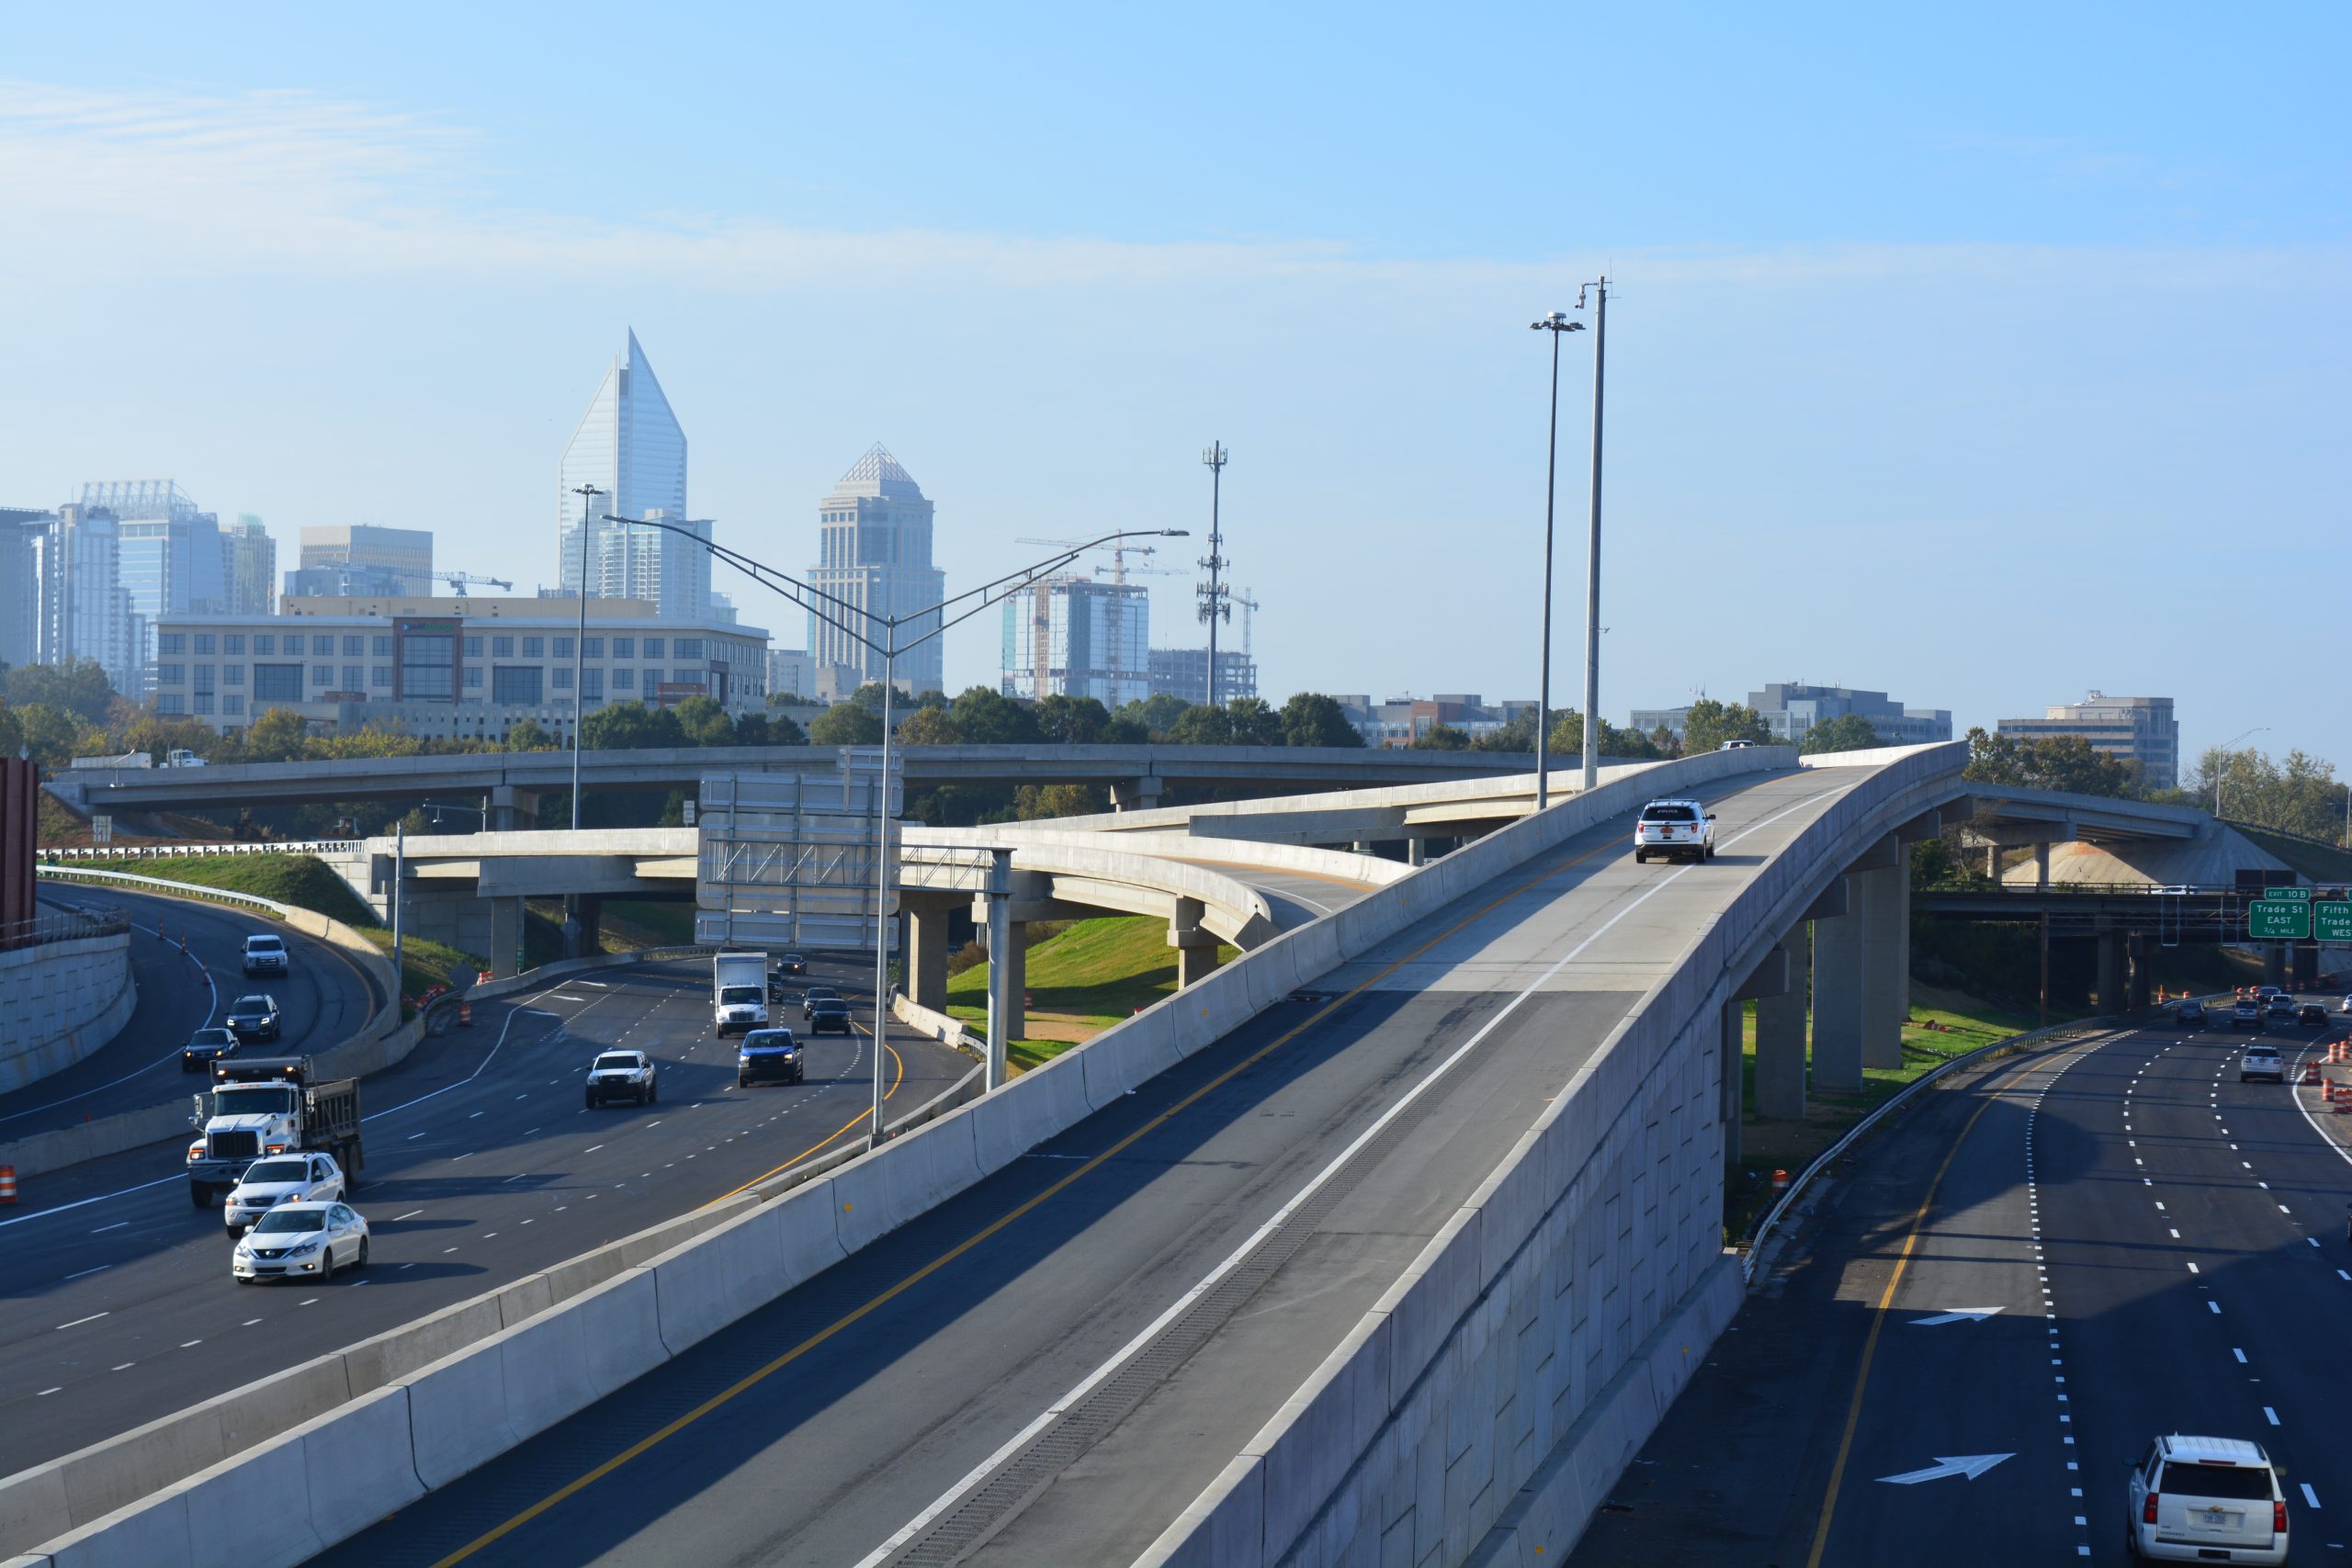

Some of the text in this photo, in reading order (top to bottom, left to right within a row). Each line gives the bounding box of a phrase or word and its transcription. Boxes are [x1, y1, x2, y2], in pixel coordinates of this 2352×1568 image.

[2256, 905, 2303, 913] Trade St
[2323, 906, 2349, 914] Fifth
[2321, 918, 2351, 926] Trade
[2332, 929, 2352, 937] WES
